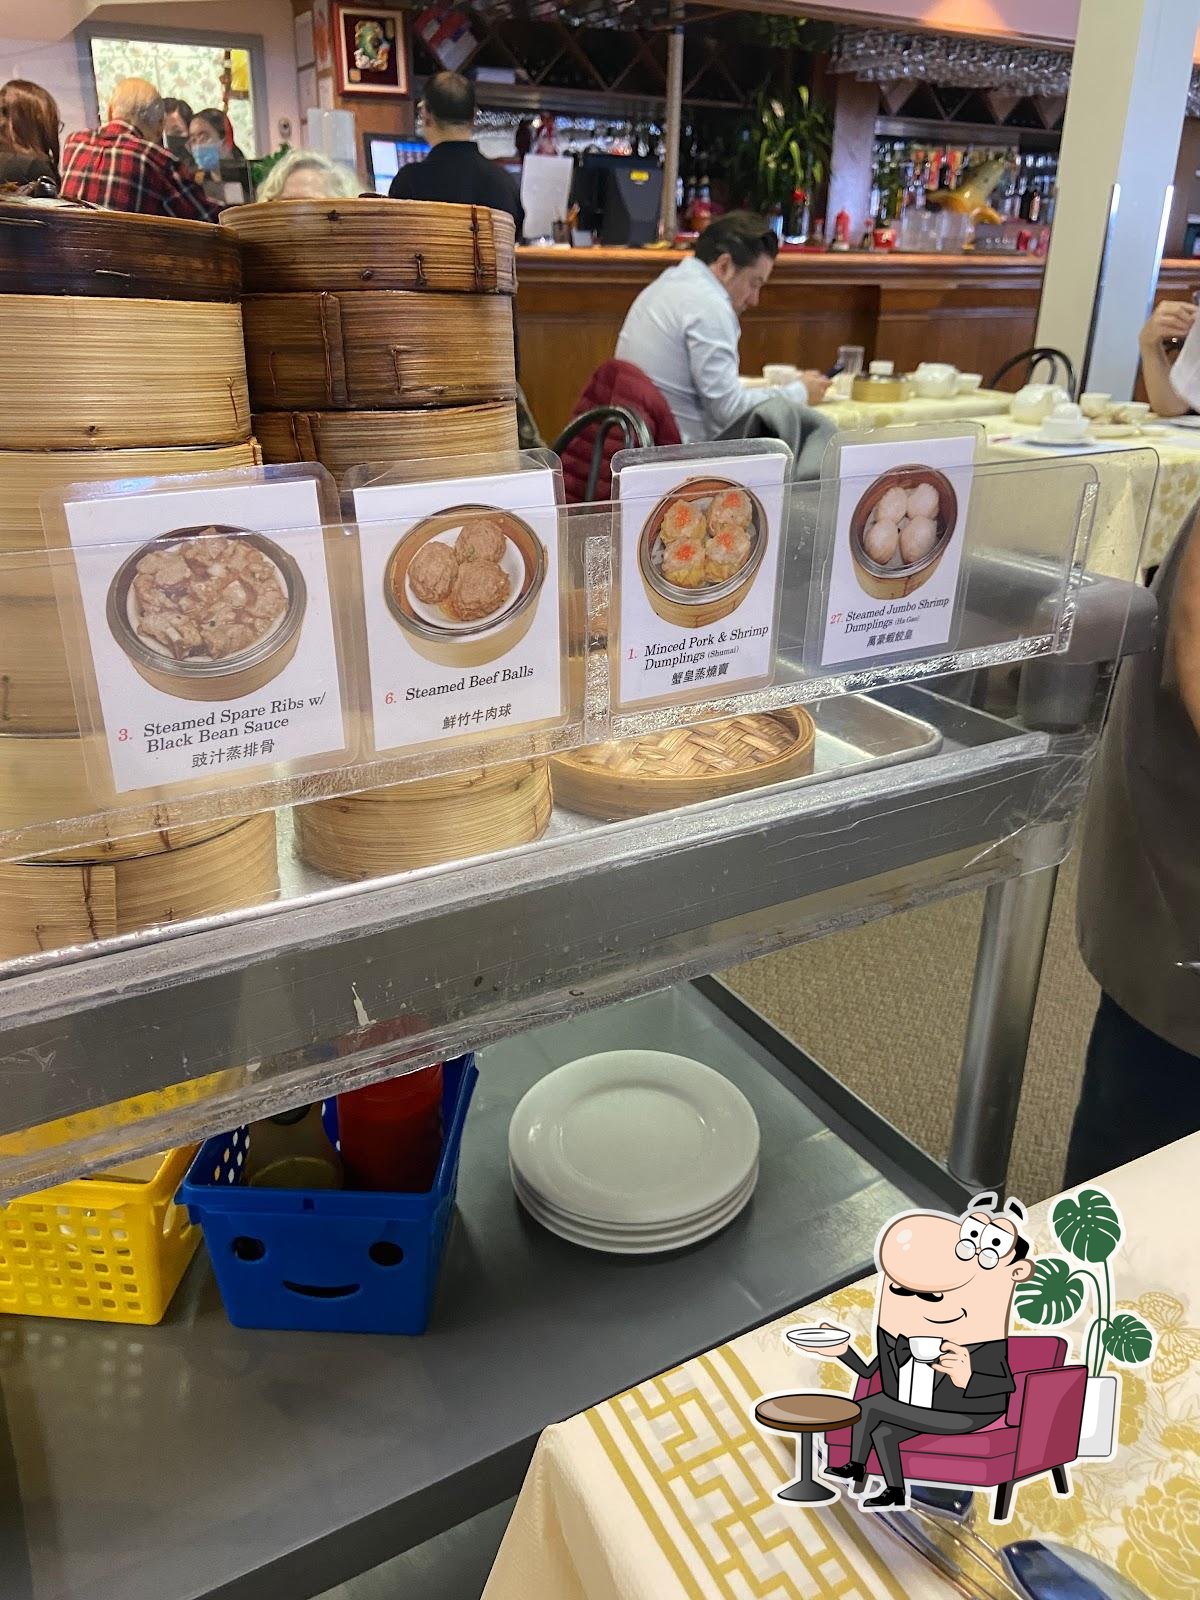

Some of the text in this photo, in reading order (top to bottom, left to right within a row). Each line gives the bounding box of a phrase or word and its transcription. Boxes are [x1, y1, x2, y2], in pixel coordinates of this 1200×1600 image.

[845, 606, 886, 622] Steamed
[886, 602, 917, 615] Jumbo
[917, 597, 950, 609] Shrimp
[844, 619, 893, 634] Dumplings
[627, 625, 769, 659] 1. Minced Pork & Shrimp
[644, 646, 739, 671] Dumplings (Shumai)
[385, 665, 534, 705] 6. Steamed Beef Balls
[118, 691, 327, 742] 3. Steamed Spare Ribs w/
[442, 703, 512, 730] 鮮竹牛肉球
[146, 716, 290, 753] Black Bean Sauce
[191, 738, 275, 768] 豉汁蒸排骨
